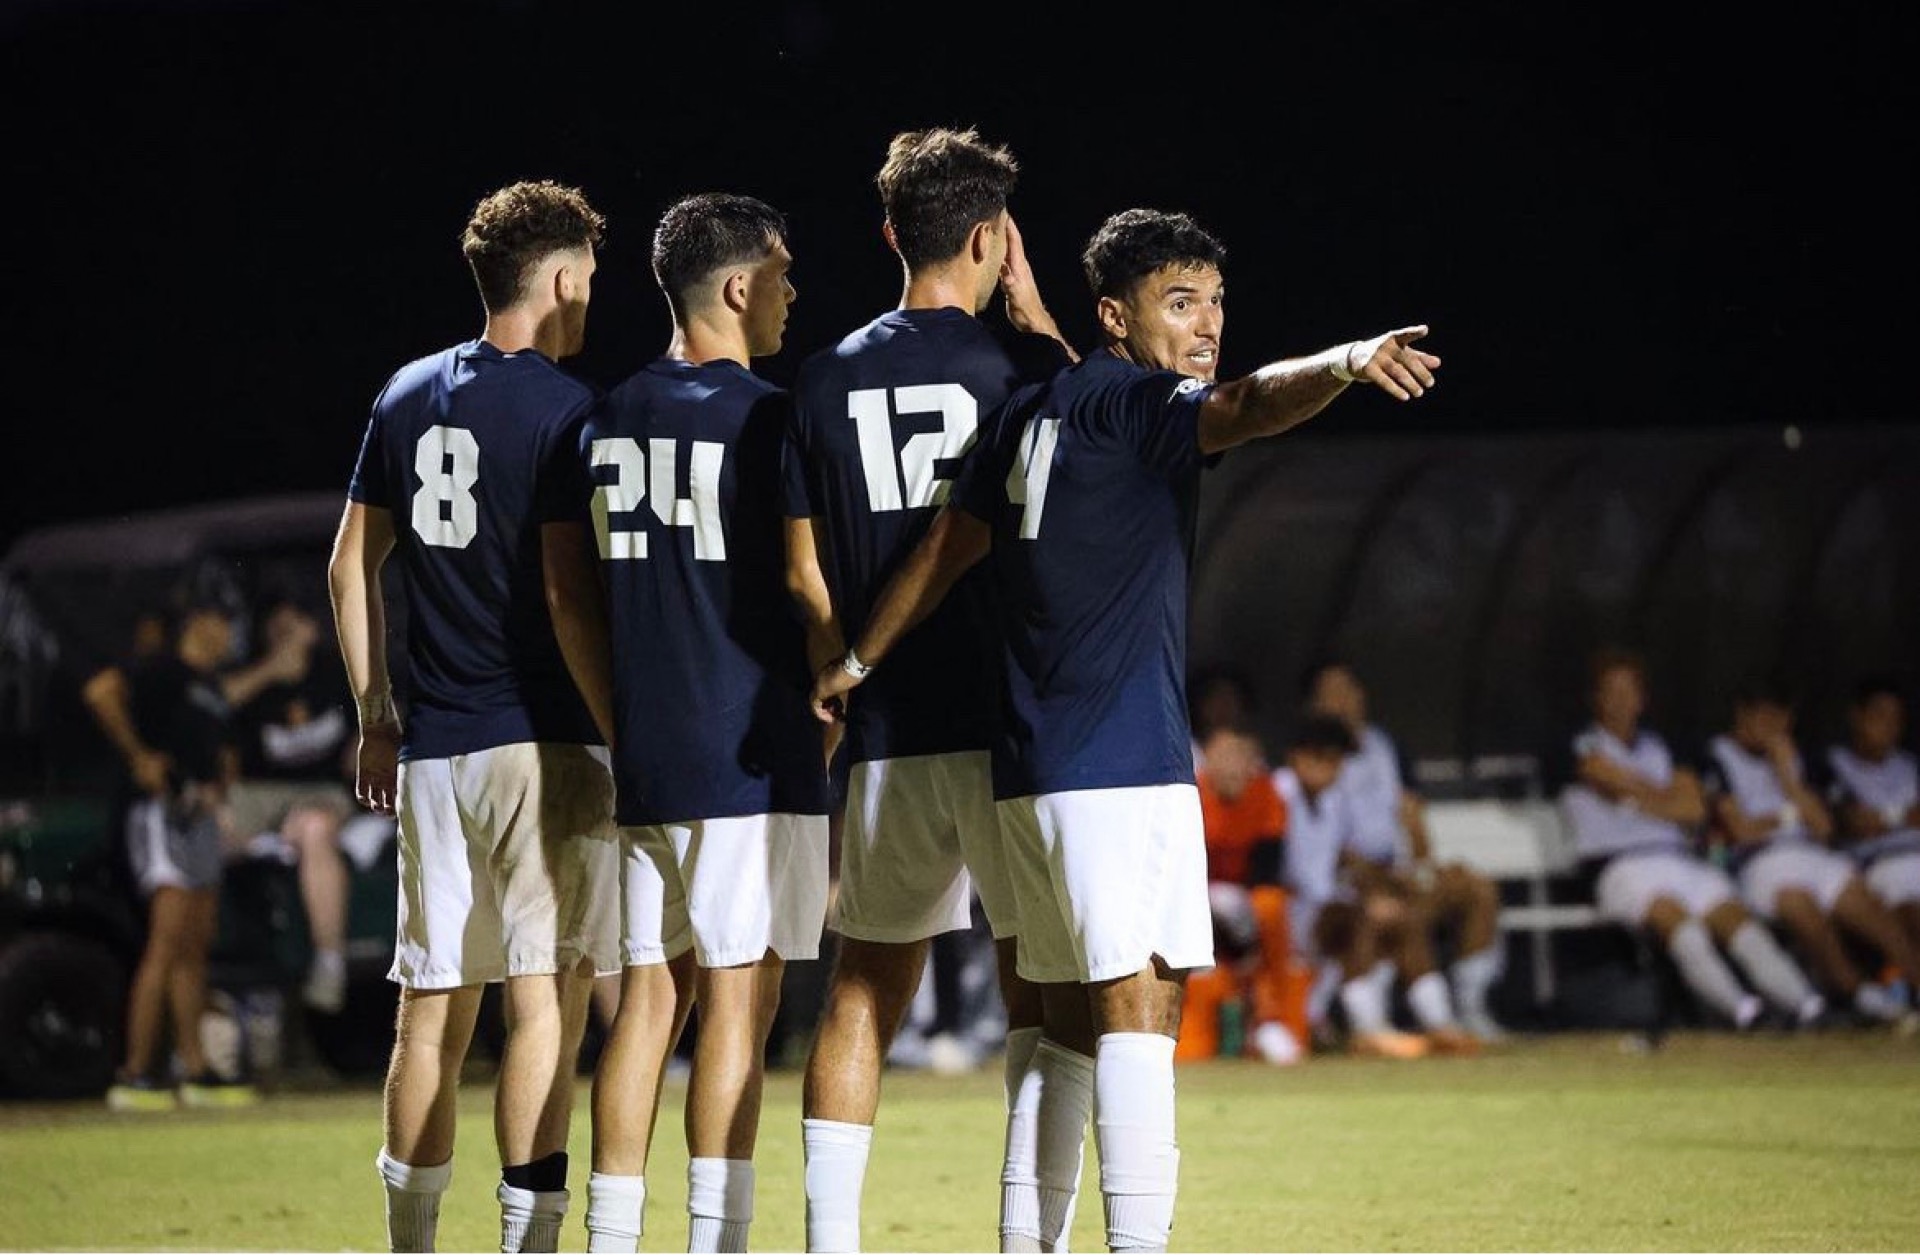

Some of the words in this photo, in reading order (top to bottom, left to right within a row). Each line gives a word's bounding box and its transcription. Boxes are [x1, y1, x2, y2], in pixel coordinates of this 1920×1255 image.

[412, 425, 480, 549] 8
[591, 437, 726, 561] 24
[848, 383, 979, 512] 12
[1006, 418, 1062, 540] 4
